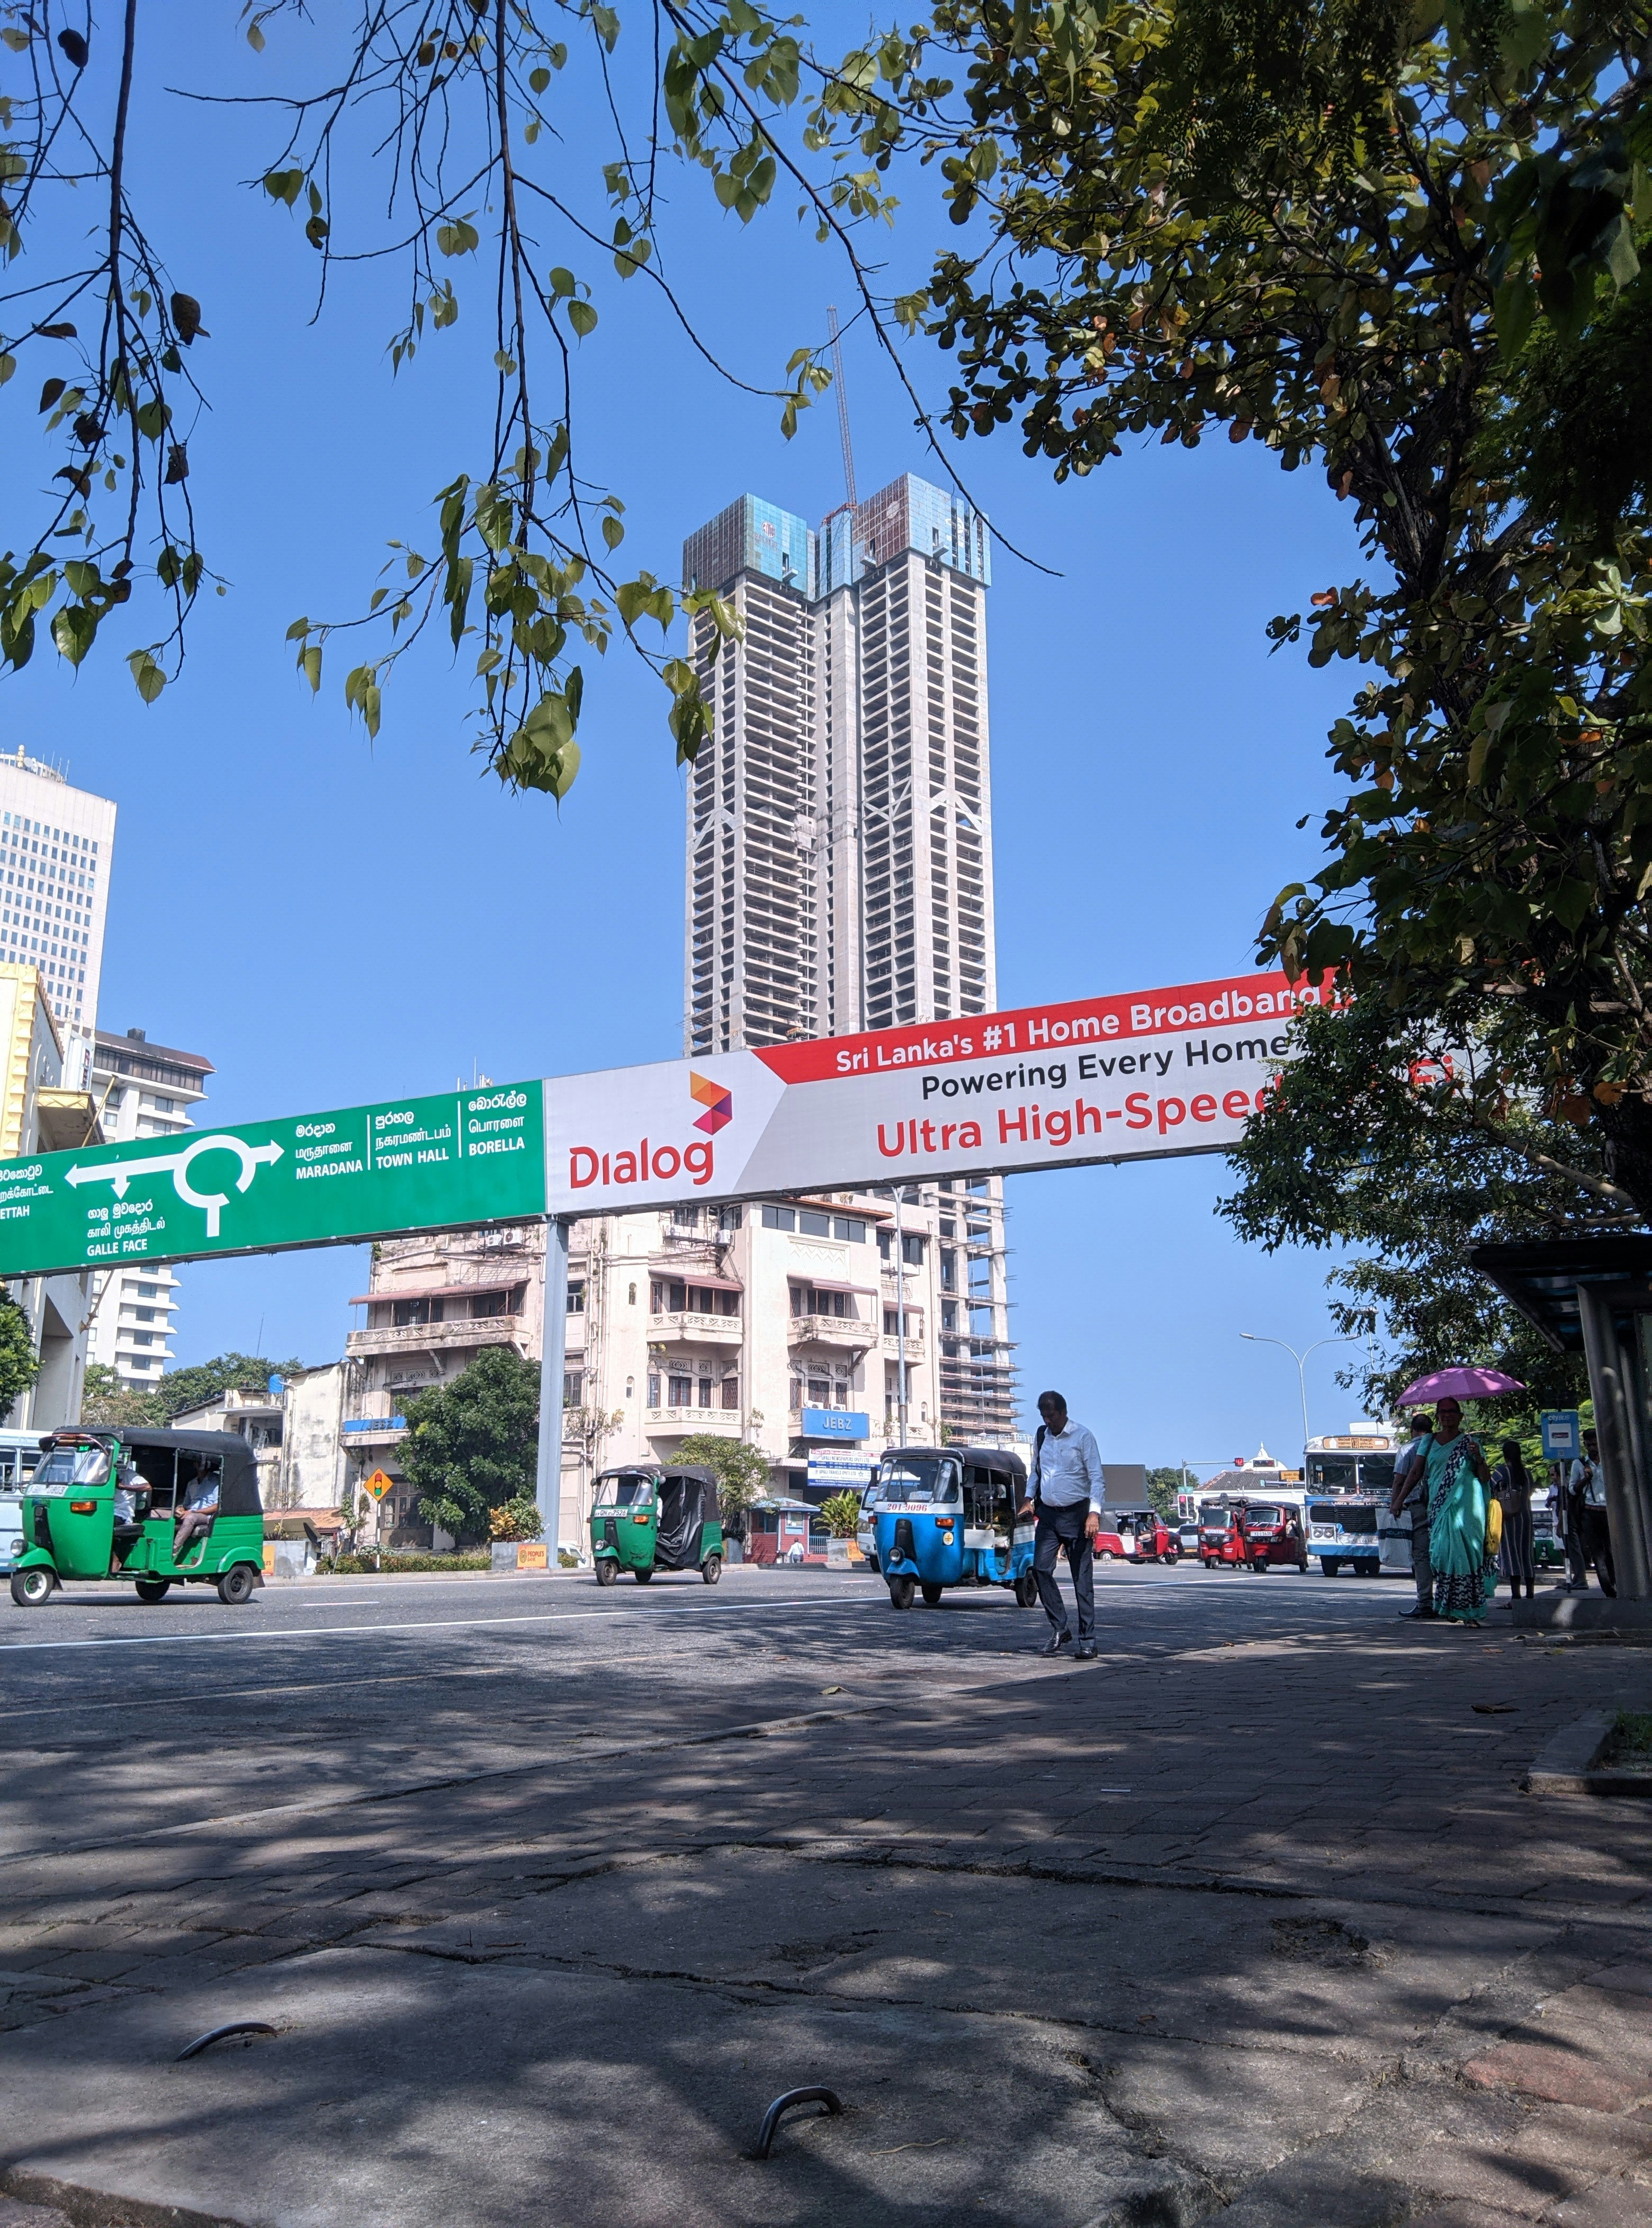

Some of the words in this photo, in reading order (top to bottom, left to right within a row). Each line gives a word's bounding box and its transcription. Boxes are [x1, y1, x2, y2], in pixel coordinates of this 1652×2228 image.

[837, 1047, 868, 1072] Sri
[877, 1035, 973, 1067] Lanka's
[983, 1022, 1016, 1050] #1
[1028, 1013, 1118, 1045] Home
[922, 1062, 1067, 1100] Powering
[1079, 1050, 1173, 1080] Every
[1186, 1036, 1289, 1066] Home
[469, 1090, 527, 1111] බොරැල්ල
[295, 1122, 336, 1137] මරදාන
[375, 1111, 415, 1129] පුරහල
[469, 1116, 525, 1134] பொரளை
[375, 1124, 451, 1151] நகரமண்டபம்
[469, 1136, 525, 1156] BORELLA
[877, 1117, 982, 1157] Ultra
[295, 1142, 353, 1161] மருதானை
[375, 1153, 412, 1169] TOWN
[418, 1148, 449, 1163] HALL
[296, 1160, 363, 1180] MARADANA
[569, 1137, 714, 1189] Dialog
[88, 1208, 109, 1220] ගාලු
[113, 1199, 153, 1219] මුවදොර
[87, 1223, 111, 1238] காலி
[114, 1217, 166, 1239] முகத்திடல்
[87, 1242, 119, 1256] GALLE
[123, 1238, 148, 1253] FACE
[367, 1420, 394, 1430] JEBZ
[823, 1416, 851, 1431] JEBZ
[887, 1503, 928, 1512] 201-9096
